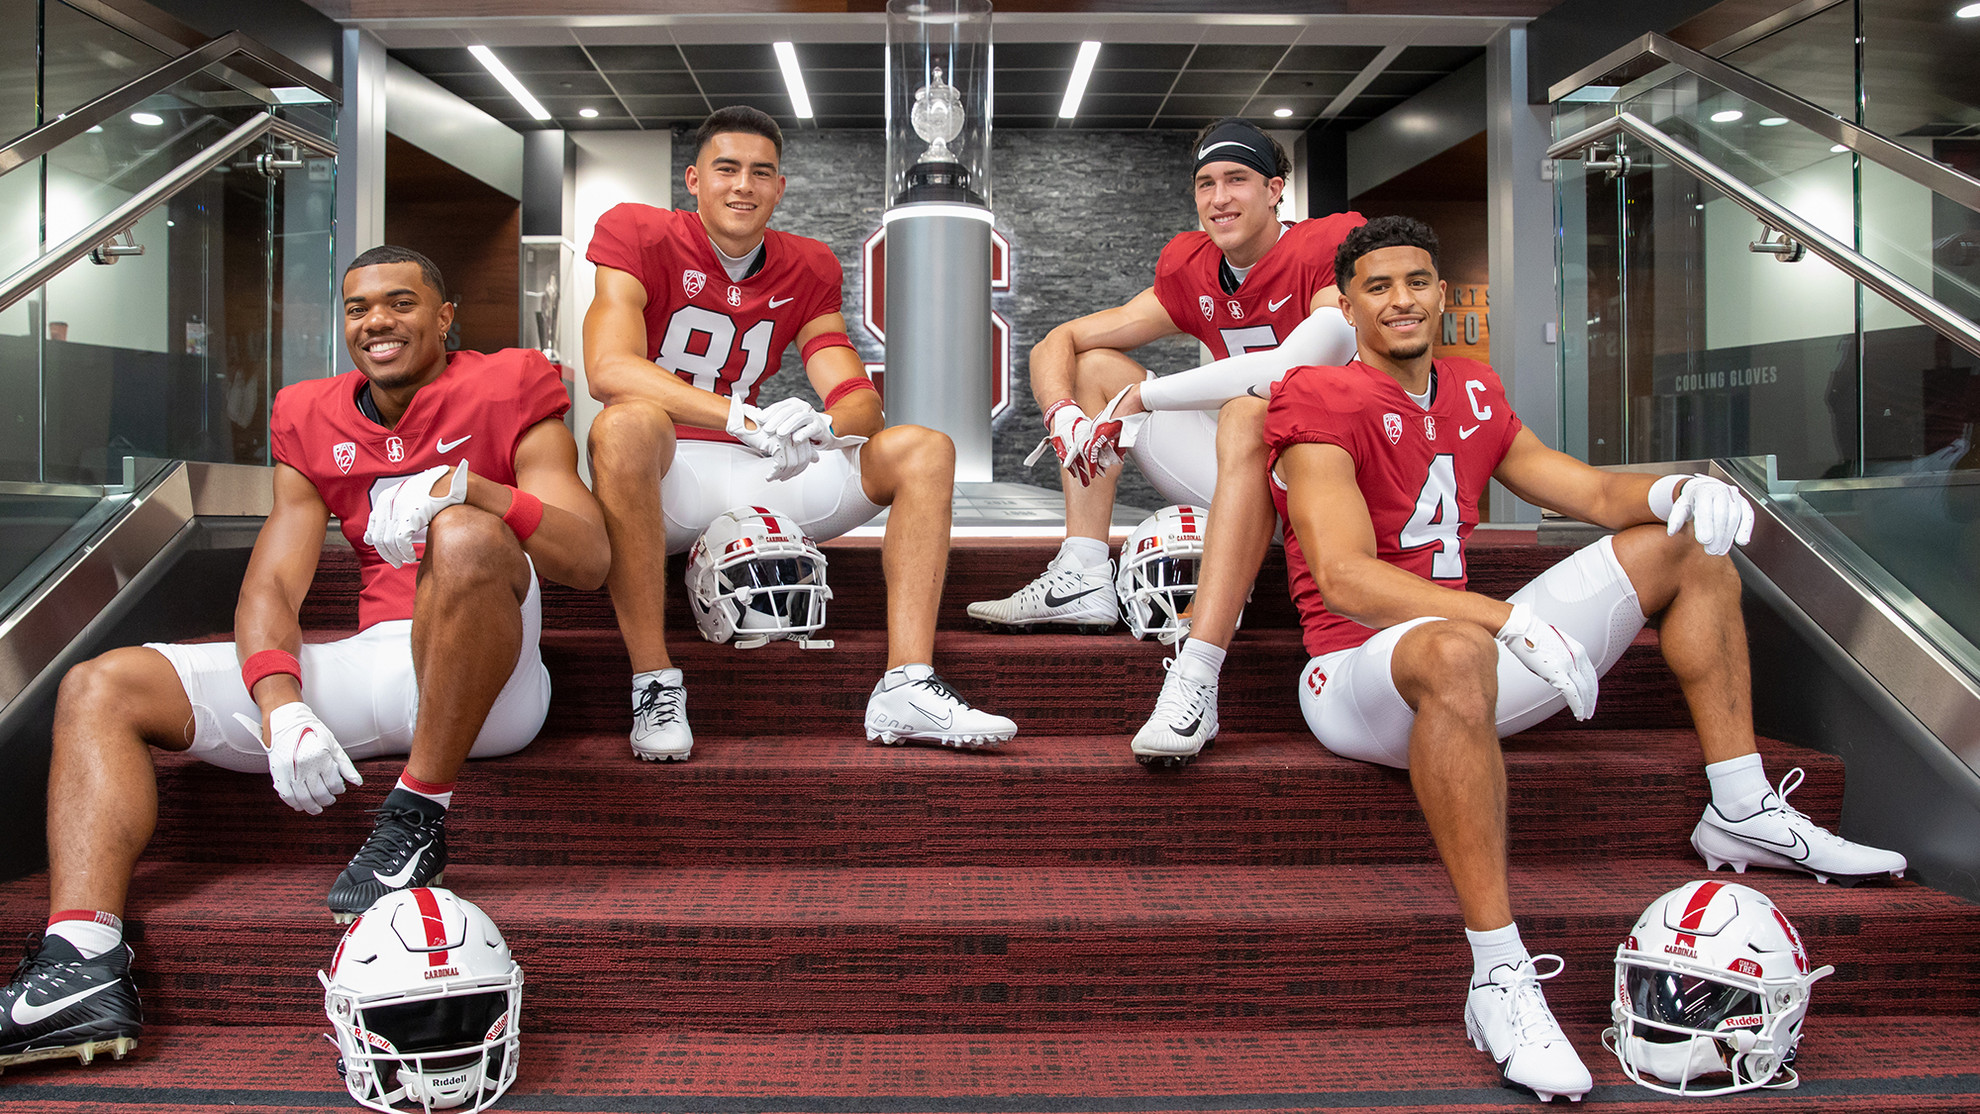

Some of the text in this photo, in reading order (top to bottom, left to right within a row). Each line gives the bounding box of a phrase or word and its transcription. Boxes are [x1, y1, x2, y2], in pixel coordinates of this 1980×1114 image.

[687, 282, 698, 293] 12
[1442, 311, 1490, 346] NO
[654, 304, 776, 403] 81
[1675, 366, 1777, 392] COOLING GLOVES
[1465, 380, 1493, 421] C
[340, 455, 350, 467] 12
[1400, 453, 1464, 581] 4
[1664, 944, 1698, 960] CARDINAL
[424, 967, 460, 980] CARDINAL
[1738, 964, 1757, 976] TREE
[1725, 1015, 1763, 1027] Riddel
[354, 1027, 391, 1049] Rddell
[432, 1074, 467, 1088] Riddell
